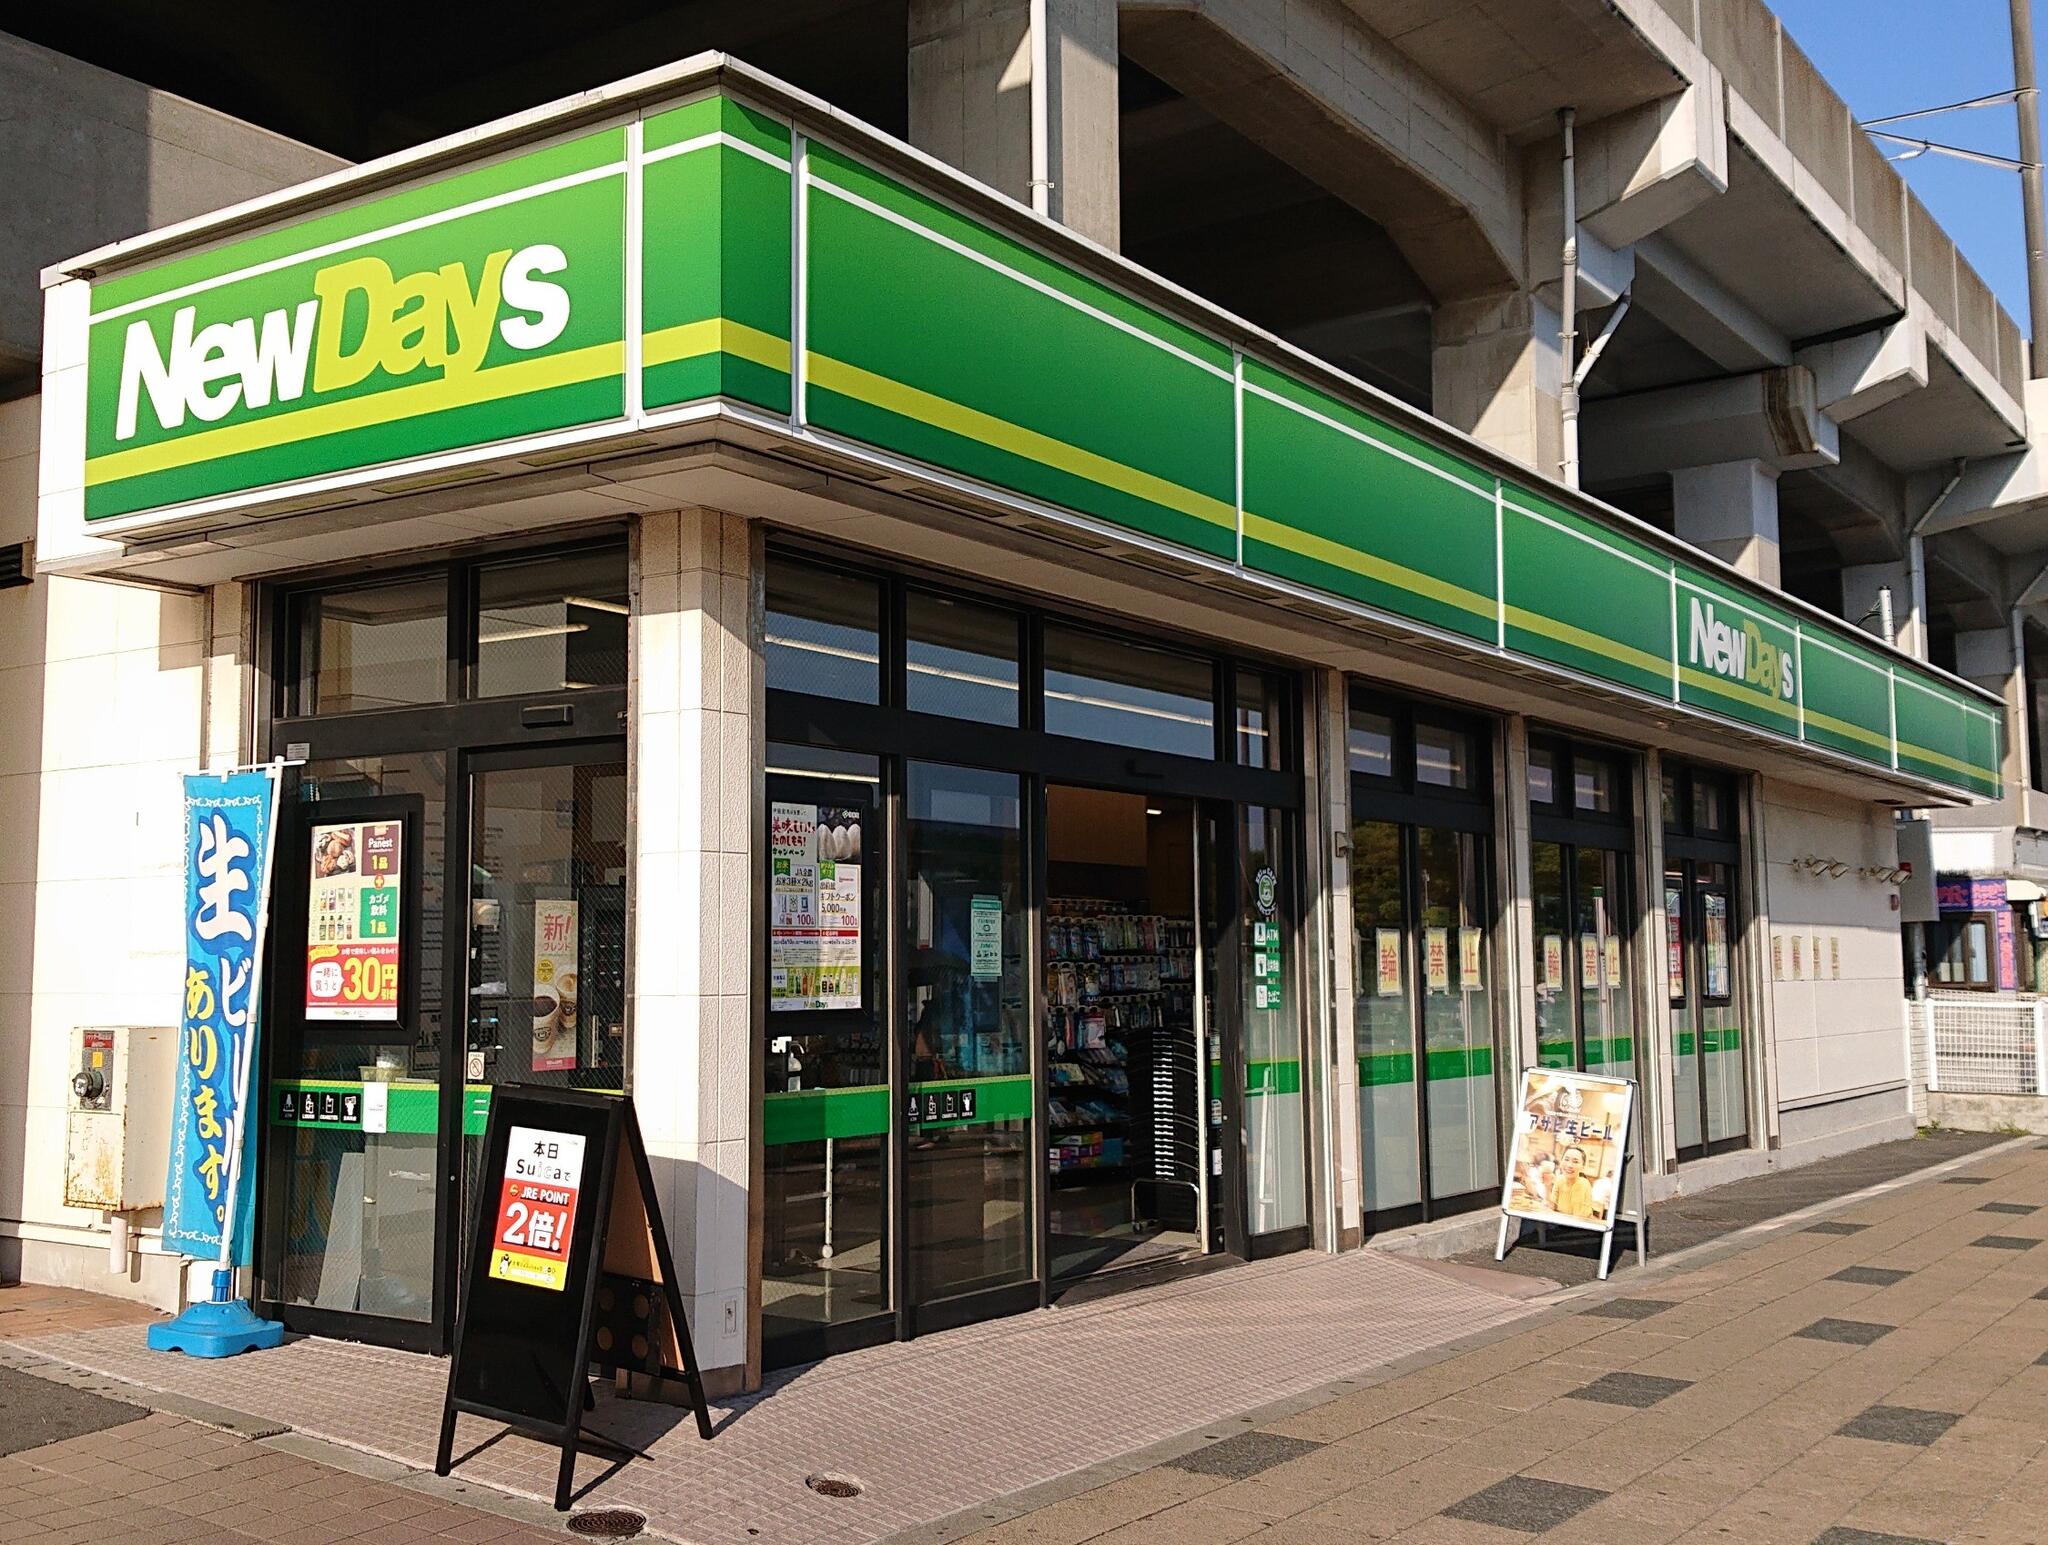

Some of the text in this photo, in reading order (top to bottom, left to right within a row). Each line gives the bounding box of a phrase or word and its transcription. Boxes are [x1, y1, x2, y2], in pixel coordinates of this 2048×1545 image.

[115, 244, 571, 441] NewDays
[1690, 597, 1794, 700] NewDays
[368, 838, 393, 849] Panest
[544, 913, 572, 942] 新!
[186, 966, 225, 1223] あります。
[1529, 1113, 1613, 1141] アサヒ生ビール
[533, 1140, 559, 1159] 本日
[515, 1158, 572, 1182] Suicaで
[521, 1186, 570, 1205] JRE POINT
[502, 1201, 568, 1251] 2倍!
